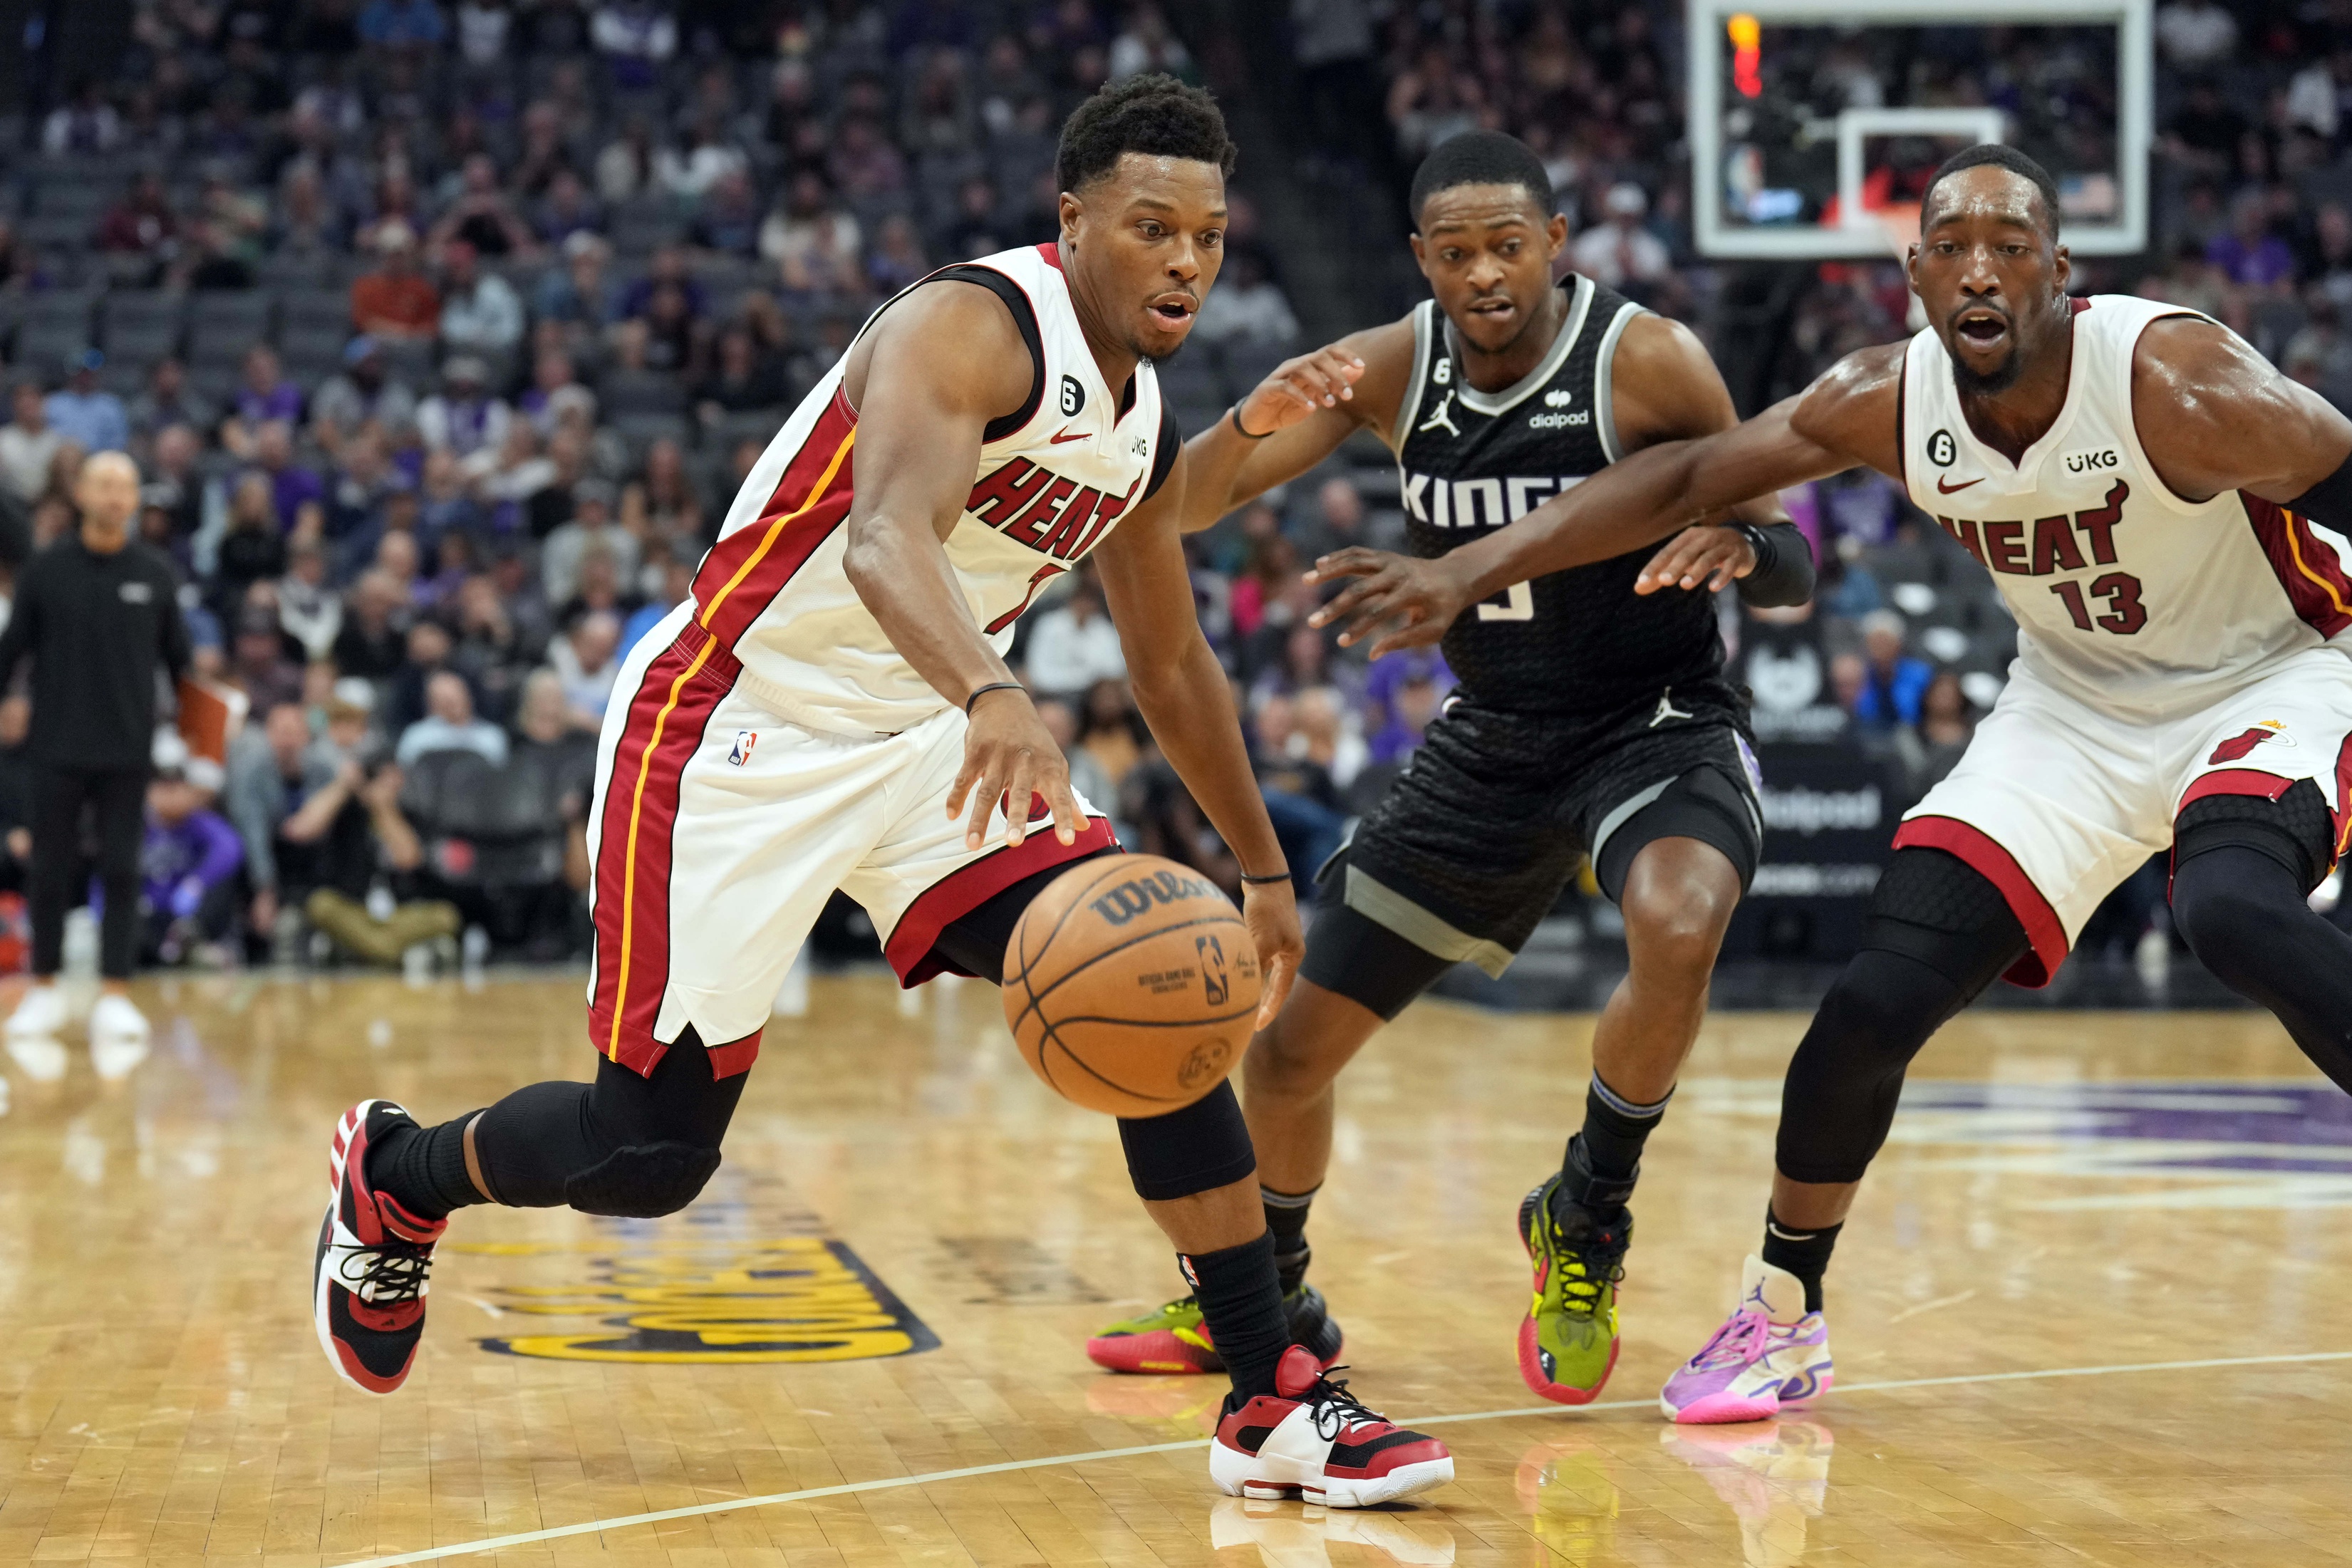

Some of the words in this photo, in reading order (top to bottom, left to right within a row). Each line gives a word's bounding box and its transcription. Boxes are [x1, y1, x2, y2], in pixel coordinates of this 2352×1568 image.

[1433, 358, 1451, 384] 6
[1062, 380, 1077, 412] 6
[1528, 410, 1589, 430] dialpad
[1934, 433, 1952, 463] 6
[965, 455, 1144, 561] HEAT
[1399, 463, 1587, 529] KING
[1937, 477, 2130, 576] HEAT
[2048, 571, 2148, 635] 13
[1761, 788, 1882, 835] ialpad
